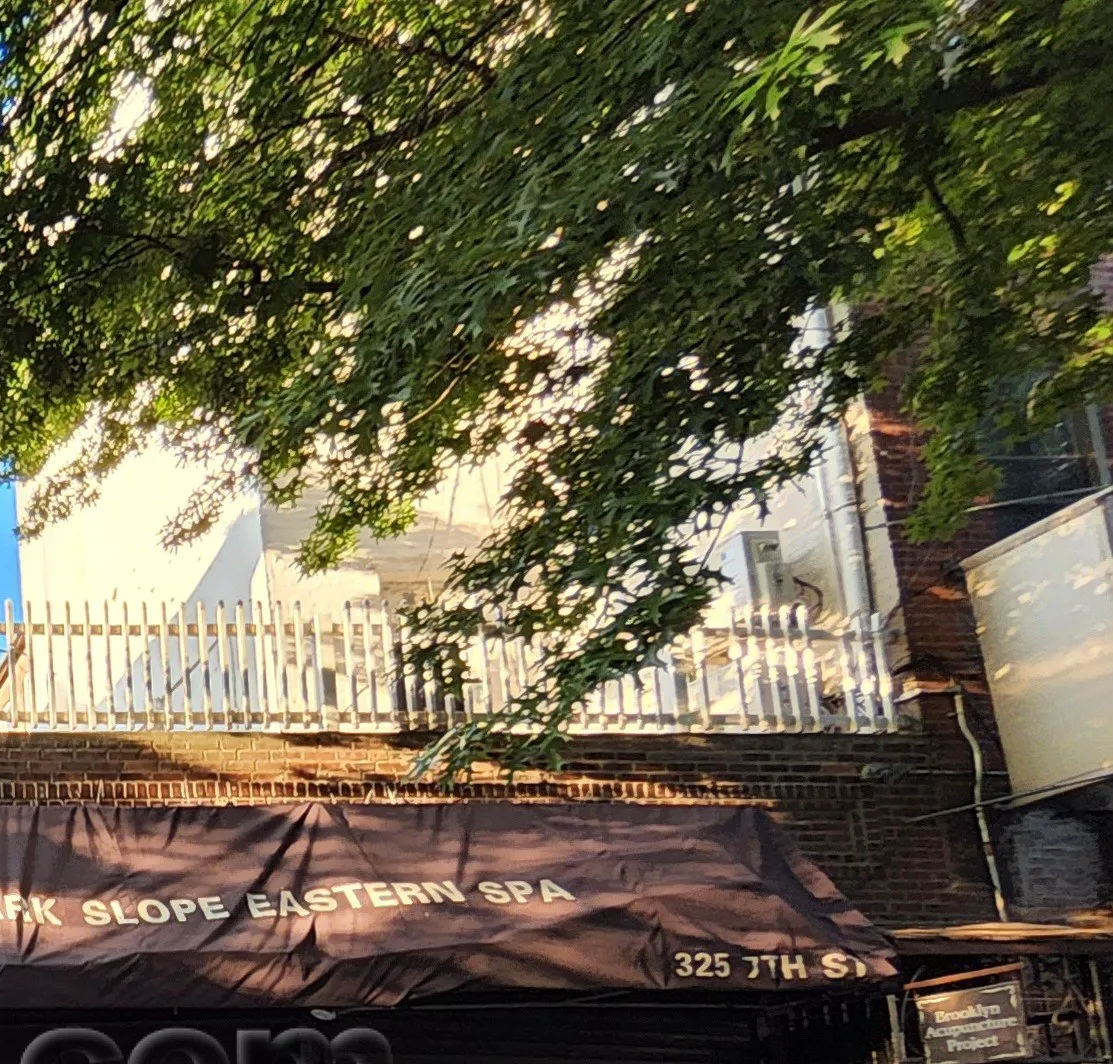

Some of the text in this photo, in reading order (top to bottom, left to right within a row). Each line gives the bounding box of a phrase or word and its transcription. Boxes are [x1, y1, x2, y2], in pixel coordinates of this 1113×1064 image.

[82, 895, 230, 926] SLOPE
[246, 880, 466, 918] EASTERN
[478, 879, 576, 904] SPA
[674, 952, 731, 978] 325
[742, 954, 808, 980] 7TH
